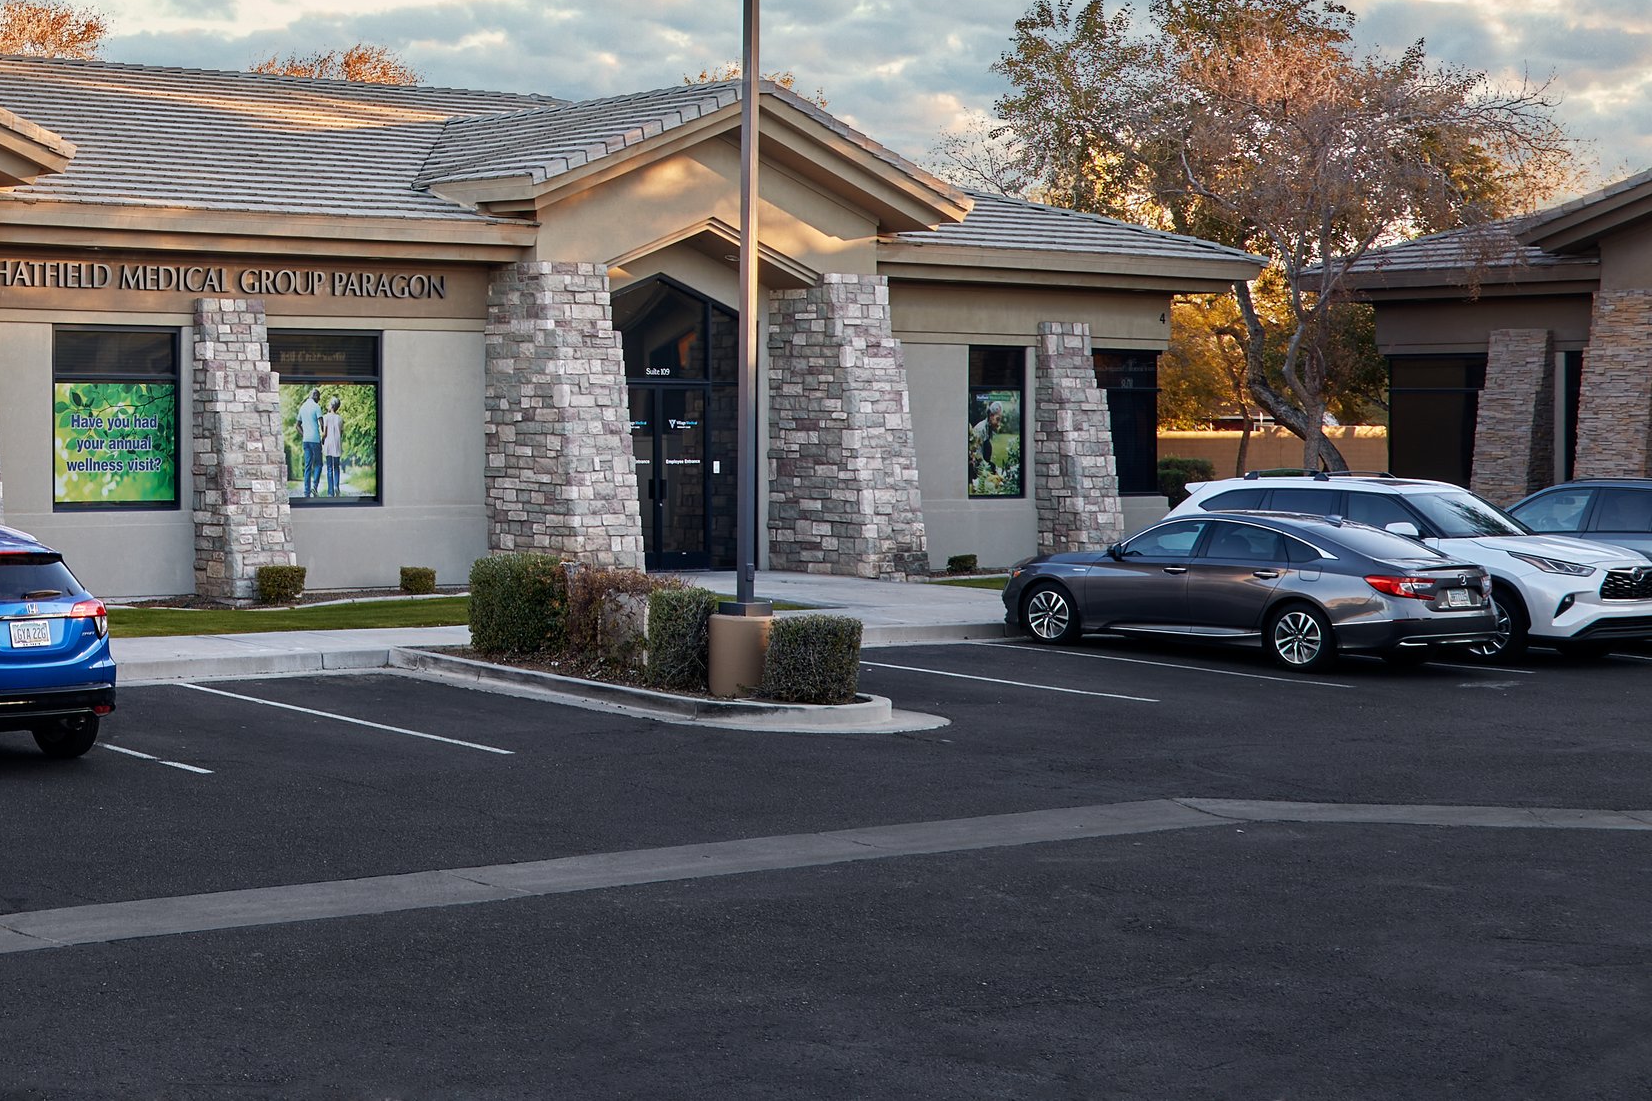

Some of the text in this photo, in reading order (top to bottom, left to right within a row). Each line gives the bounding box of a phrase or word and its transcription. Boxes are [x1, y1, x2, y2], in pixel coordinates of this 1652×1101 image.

[120, 264, 229, 293] MEDICAL
[239, 268, 326, 296] GROUP
[332, 271, 446, 299] PARAGON
[1159, 313, 1166, 324] 4
[646, 367, 670, 376] Suite 109
[71, 414, 157, 431] Have you had
[77, 436, 152, 452] your annual
[66, 458, 162, 472] wellness visit?
[17, 627, 47, 640] GYA 22G
